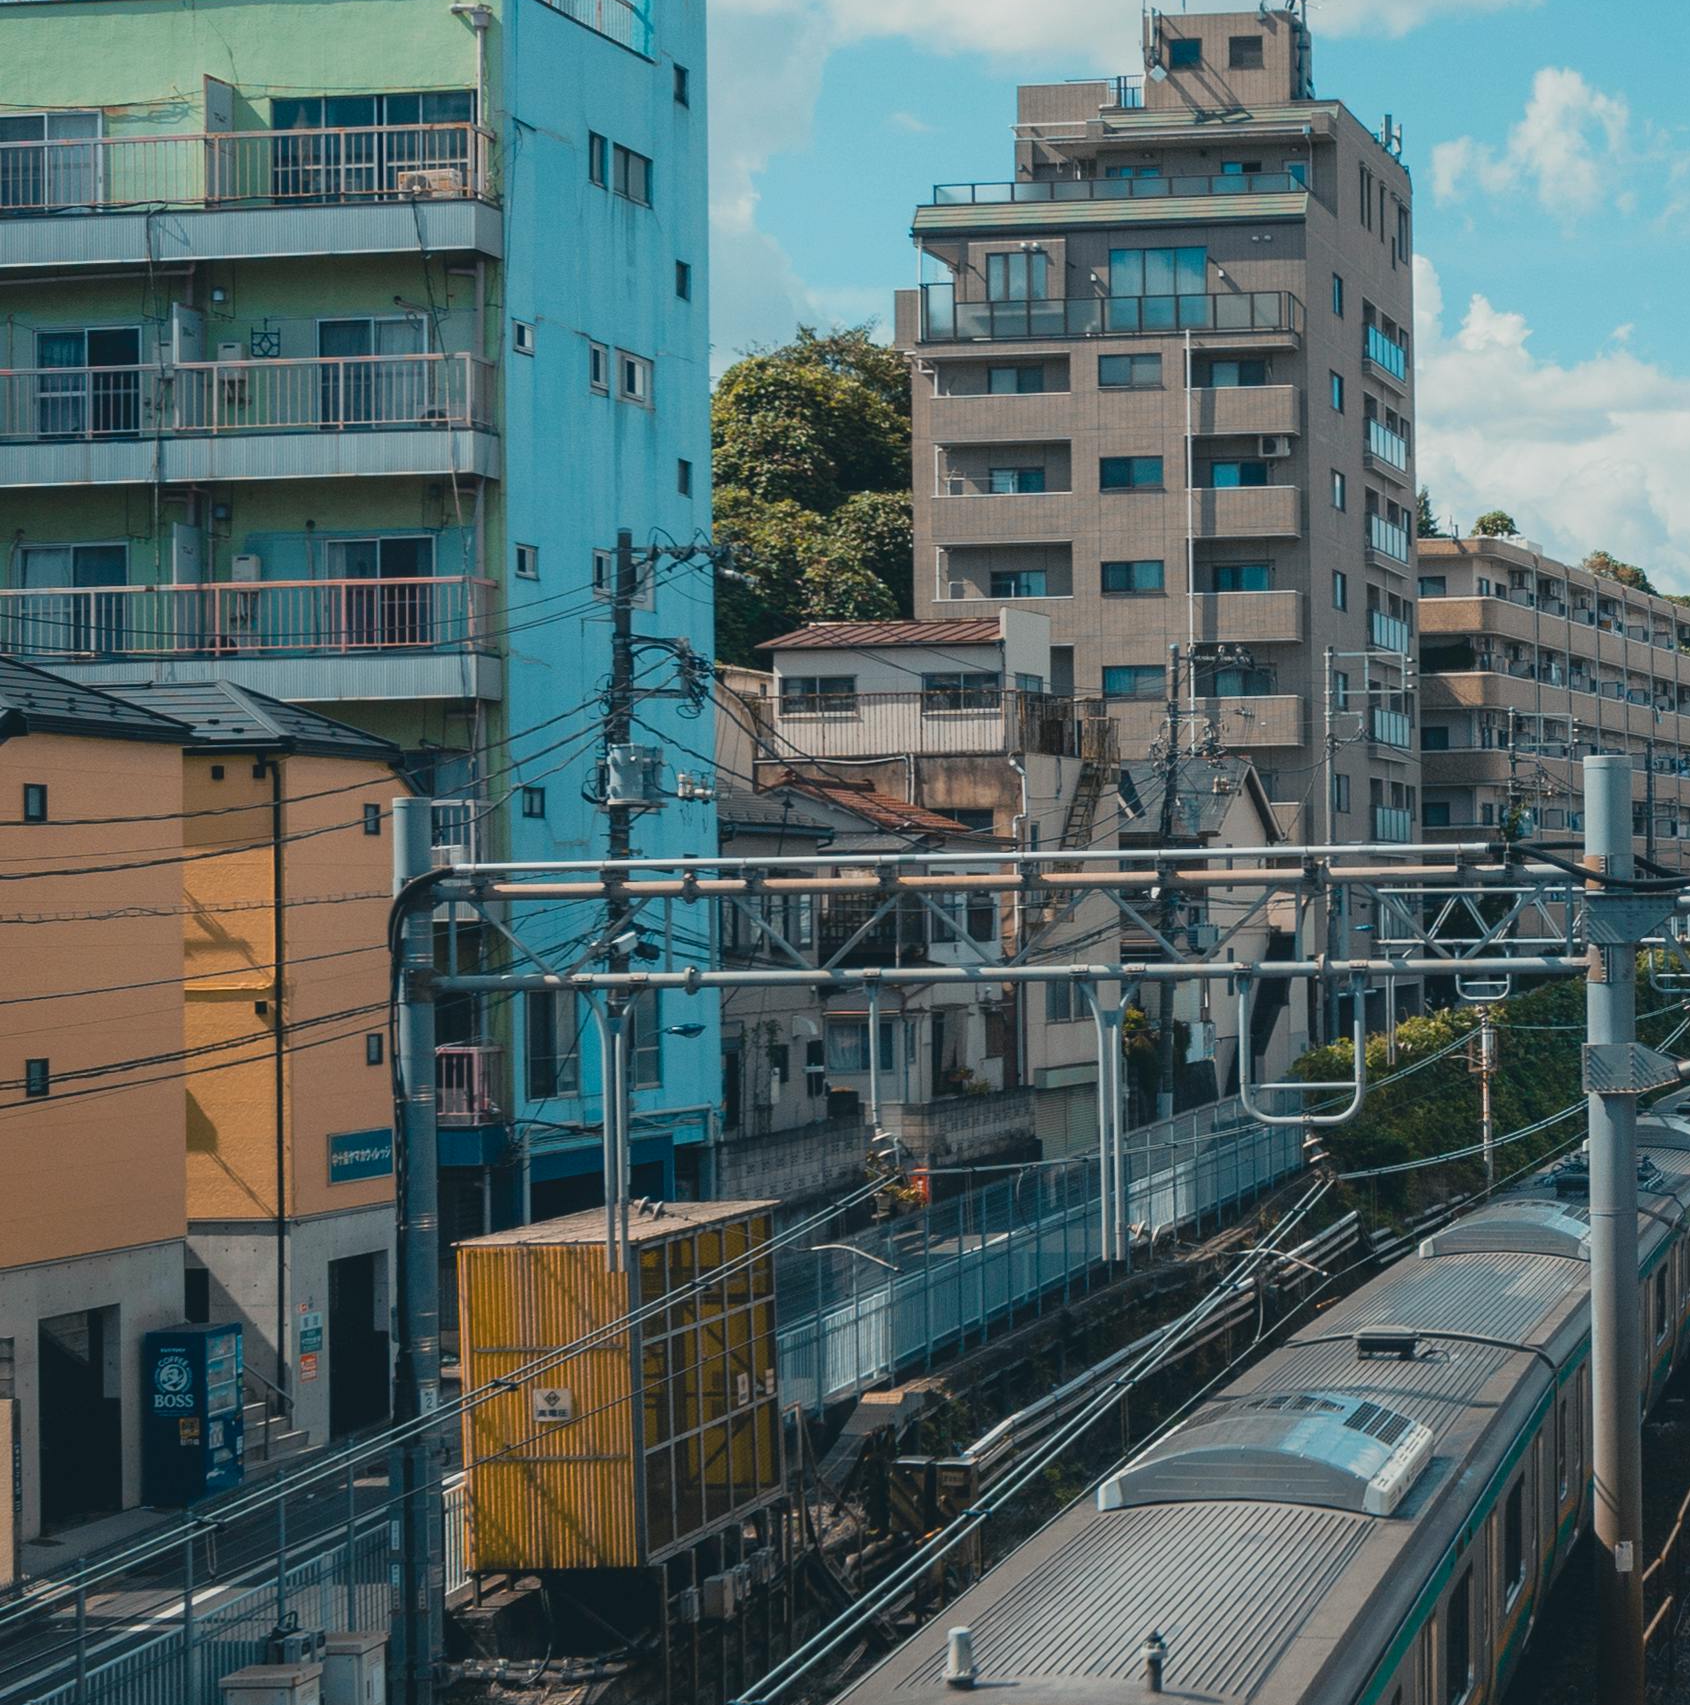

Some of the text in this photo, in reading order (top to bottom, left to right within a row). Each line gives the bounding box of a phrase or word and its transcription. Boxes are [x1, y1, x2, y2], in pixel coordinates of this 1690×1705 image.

[158, 1356, 189, 1368] COFFEE
[154, 1394, 194, 1408] BOSS
[425, 1397, 433, 1409] 2
